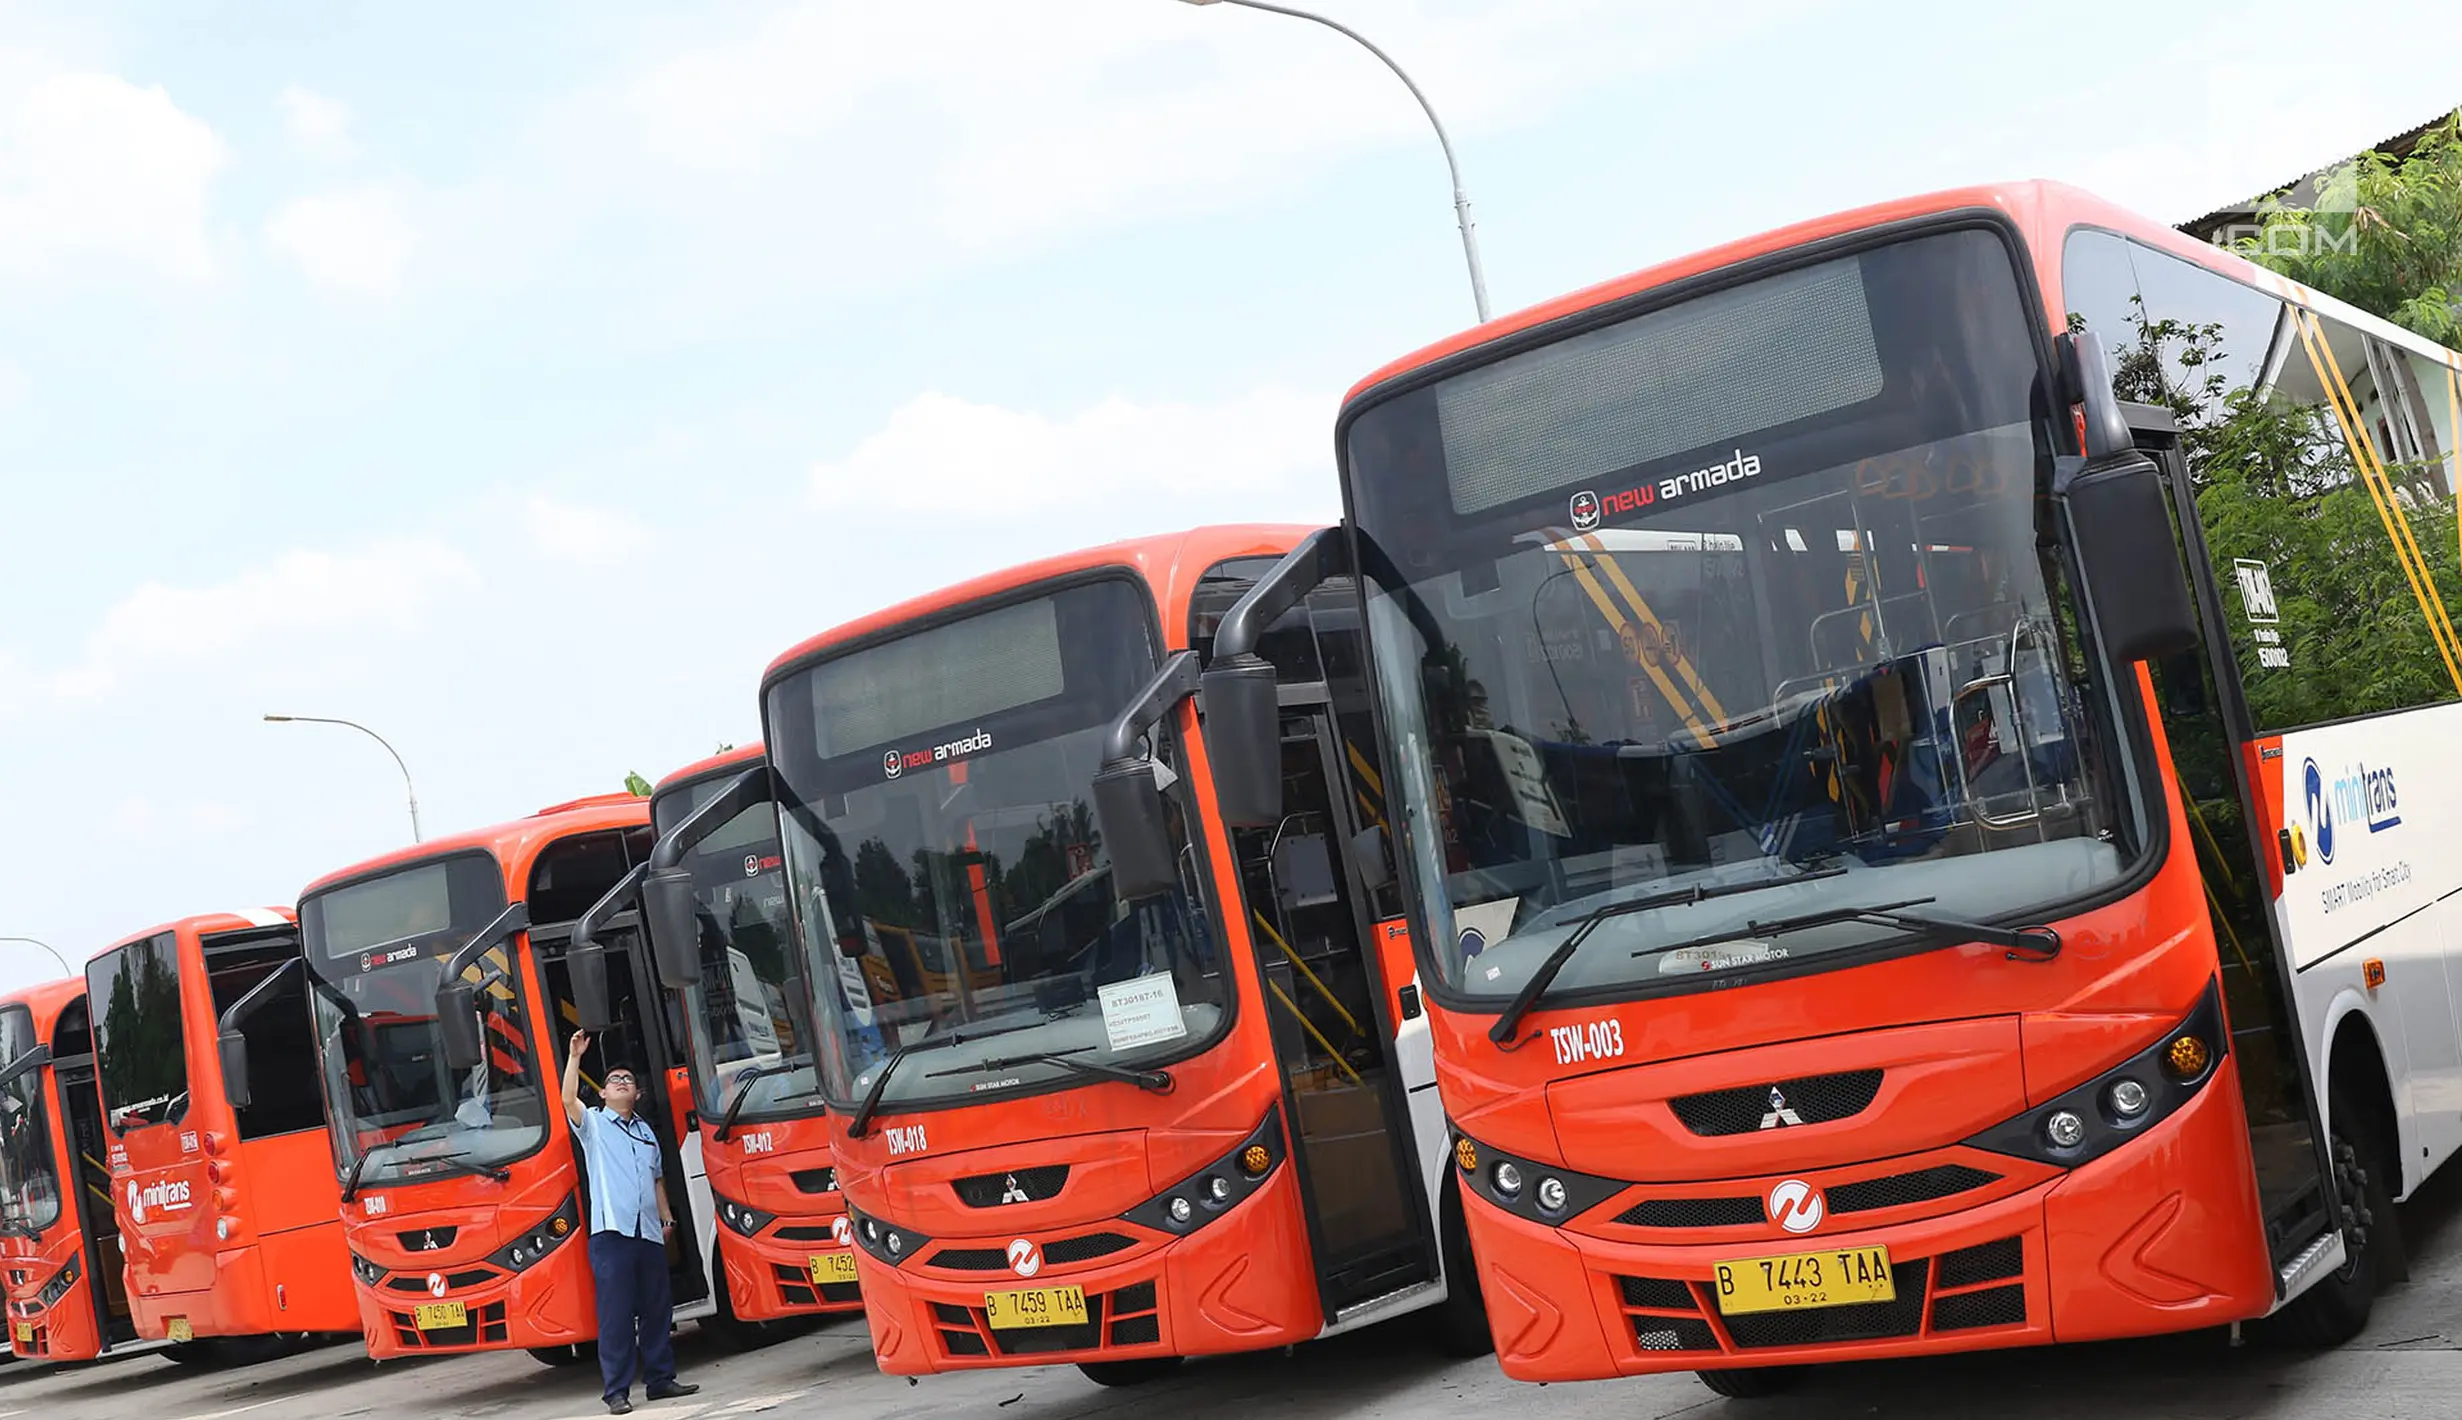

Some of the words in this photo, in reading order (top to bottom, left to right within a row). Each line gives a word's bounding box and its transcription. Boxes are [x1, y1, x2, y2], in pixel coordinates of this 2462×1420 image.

[1602, 484, 1656, 516] new
[1659, 448, 1761, 500] armada
[902, 748, 933, 768] new
[934, 728, 992, 761] armada
[2334, 761, 2398, 828] minitrans
[758, 855, 781, 870] new
[2321, 883, 2347, 914] SMART
[386, 943, 418, 963] armada
[1711, 957, 1730, 970] SUN
[1755, 948, 1789, 963] MOTOR
[1550, 1018, 1624, 1065] TSW-003
[885, 1125, 927, 1155] TSW-018
[143, 1180, 191, 1208] minitrans
[811, 1258, 819, 1275] B
[827, 1255, 855, 1273] 7452
[1718, 1265, 1735, 1296] B
[1759, 1257, 1823, 1292] 7443
[1838, 1250, 1888, 1285] TAA
[986, 1295, 997, 1316] B
[1010, 1291, 1047, 1315] 7459
[1054, 1288, 1084, 1312] TAA
